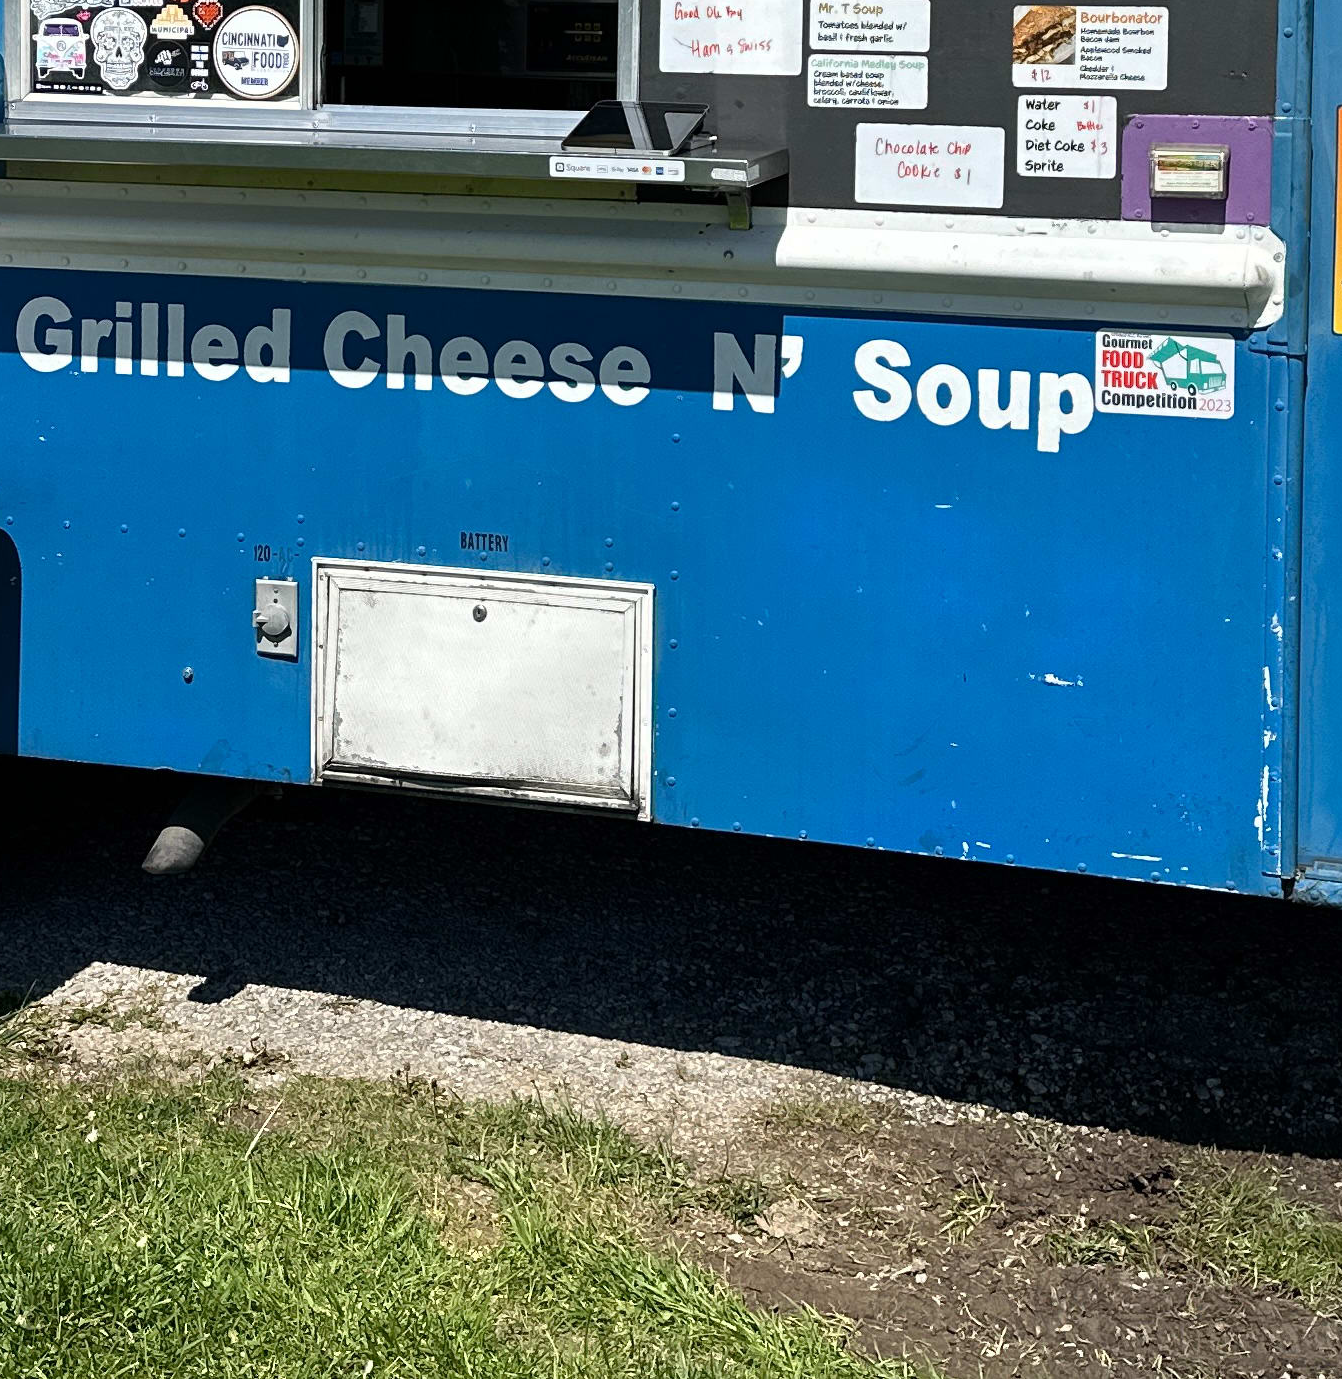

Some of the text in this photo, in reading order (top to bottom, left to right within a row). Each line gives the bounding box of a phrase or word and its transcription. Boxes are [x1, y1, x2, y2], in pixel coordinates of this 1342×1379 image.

[674, 1, 700, 20] Good
[818, 3, 884, 17] Mr. T Soup
[1080, 11, 1163, 24] Bourbonator
[151, 26, 193, 34] MUNICIPAL
[818, 21, 894, 30] Tomatoes blended
[222, 32, 276, 48] CINCINNATI
[818, 32, 894, 44] basil fresh garlic
[691, 38, 773, 58] Ham Swiss
[253, 51, 282, 69] FOOD
[810, 58, 926, 72] California Medley Soup
[813, 78, 844, 87] blended
[1025, 98, 1061, 111] Water
[1025, 118, 1056, 131] Coke
[875, 137, 972, 156] Chocolate Chip
[1025, 138, 1052, 151] Diet
[1054, 139, 1086, 152] Coke
[566, 163, 591, 173] Square
[897, 161, 941, 179] Cookie
[1024, 159, 1064, 174] Sprite
[1102, 334, 1153, 350] Gourmet
[1102, 350, 1145, 369] FOOD
[16, 296, 291, 384] Grilled
[324, 310, 652, 406] Cheese
[853, 339, 1094, 453] Soup
[1101, 370, 1159, 390] TRUCK
[1101, 390, 1232, 412] Competition 2023
[460, 532, 509, 553] BATTERY
